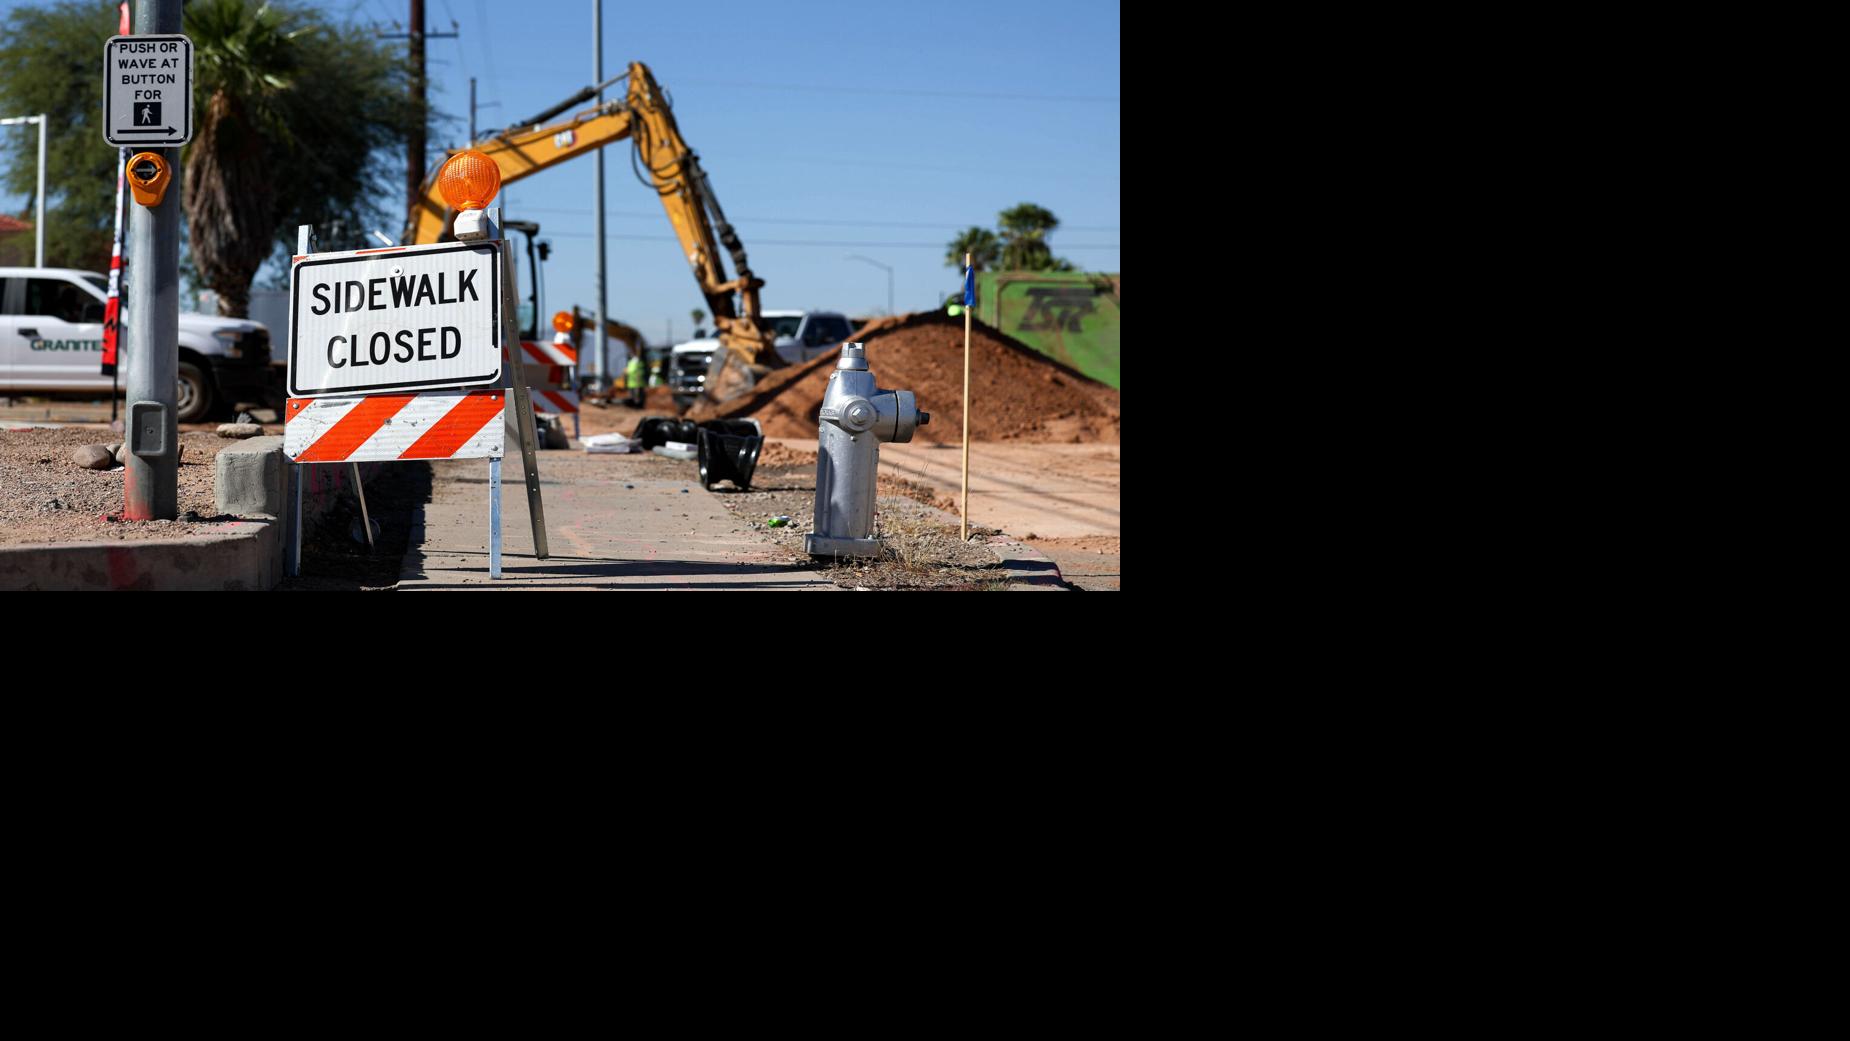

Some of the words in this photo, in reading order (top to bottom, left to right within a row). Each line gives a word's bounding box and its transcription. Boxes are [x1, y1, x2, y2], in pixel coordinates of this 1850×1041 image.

[120, 43, 156, 53] PUSH
[160, 43, 178, 53] OR
[118, 58, 157, 69] WAVE
[161, 58, 179, 68] AT
[122, 74, 175, 85] BUTTON
[135, 90, 162, 100] FOR
[311, 268, 479, 316] SIDEWALK
[30, 339, 103, 352] GRANITE
[327, 326, 462, 369] CLOSED
